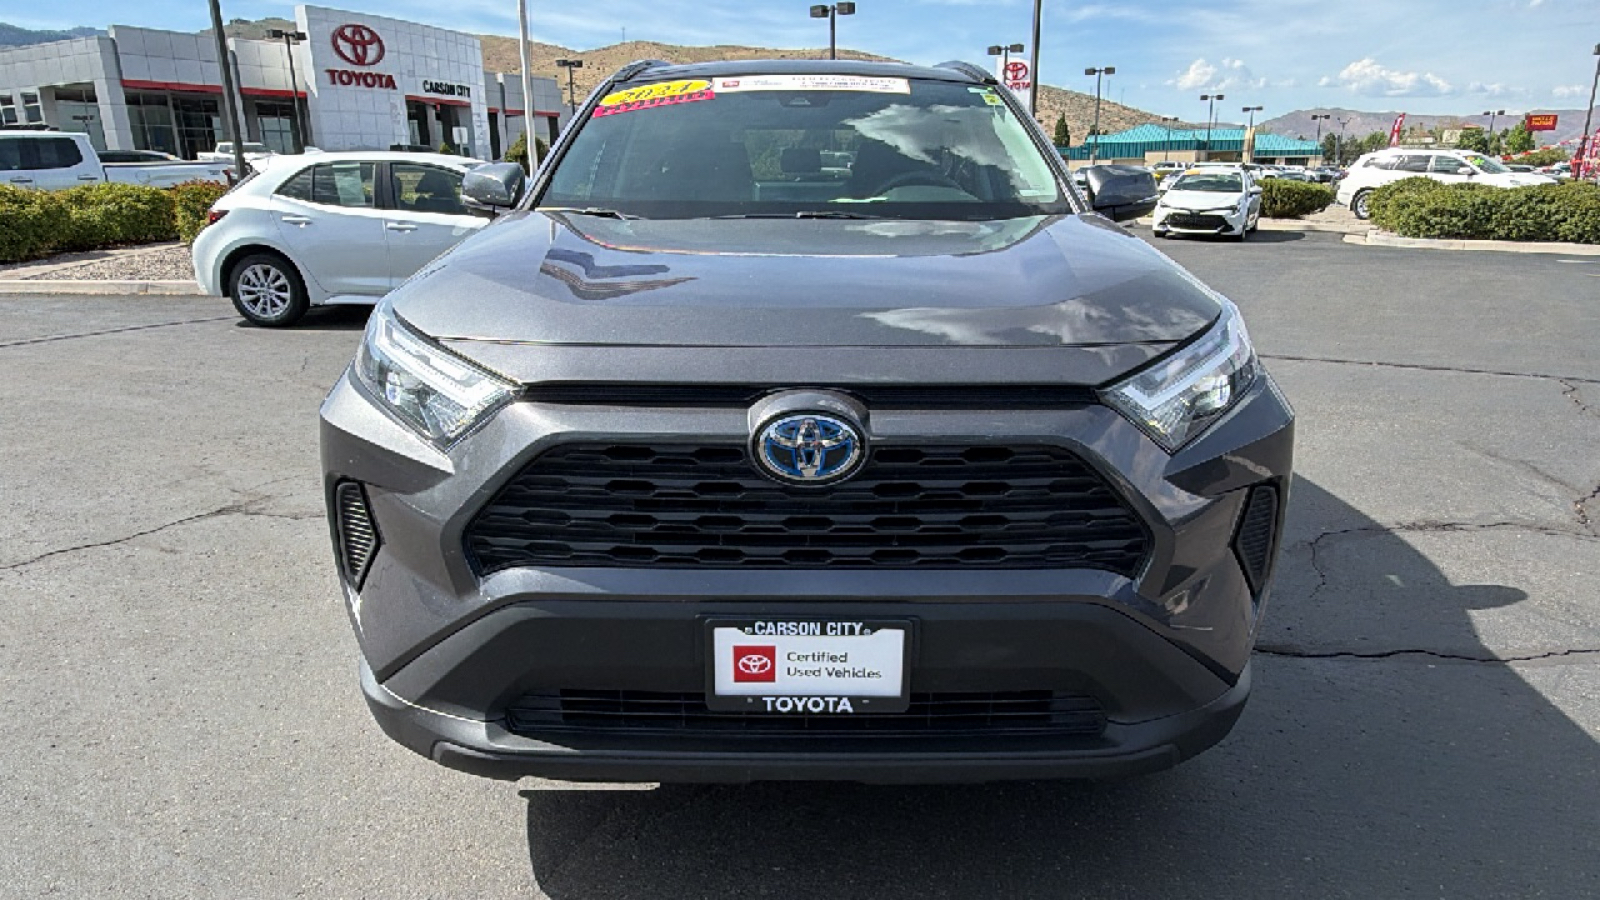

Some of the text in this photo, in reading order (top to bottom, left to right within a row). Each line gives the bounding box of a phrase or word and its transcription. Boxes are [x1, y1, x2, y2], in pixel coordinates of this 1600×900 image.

[326, 69, 397, 90] TOYOTA
[423, 79, 455, 96] CARSON
[754, 621, 863, 636] CARSON CITY
[786, 652, 848, 663] Certified
[786, 667, 882, 678] Used Vehicles
[762, 697, 853, 713] TOYOTA
